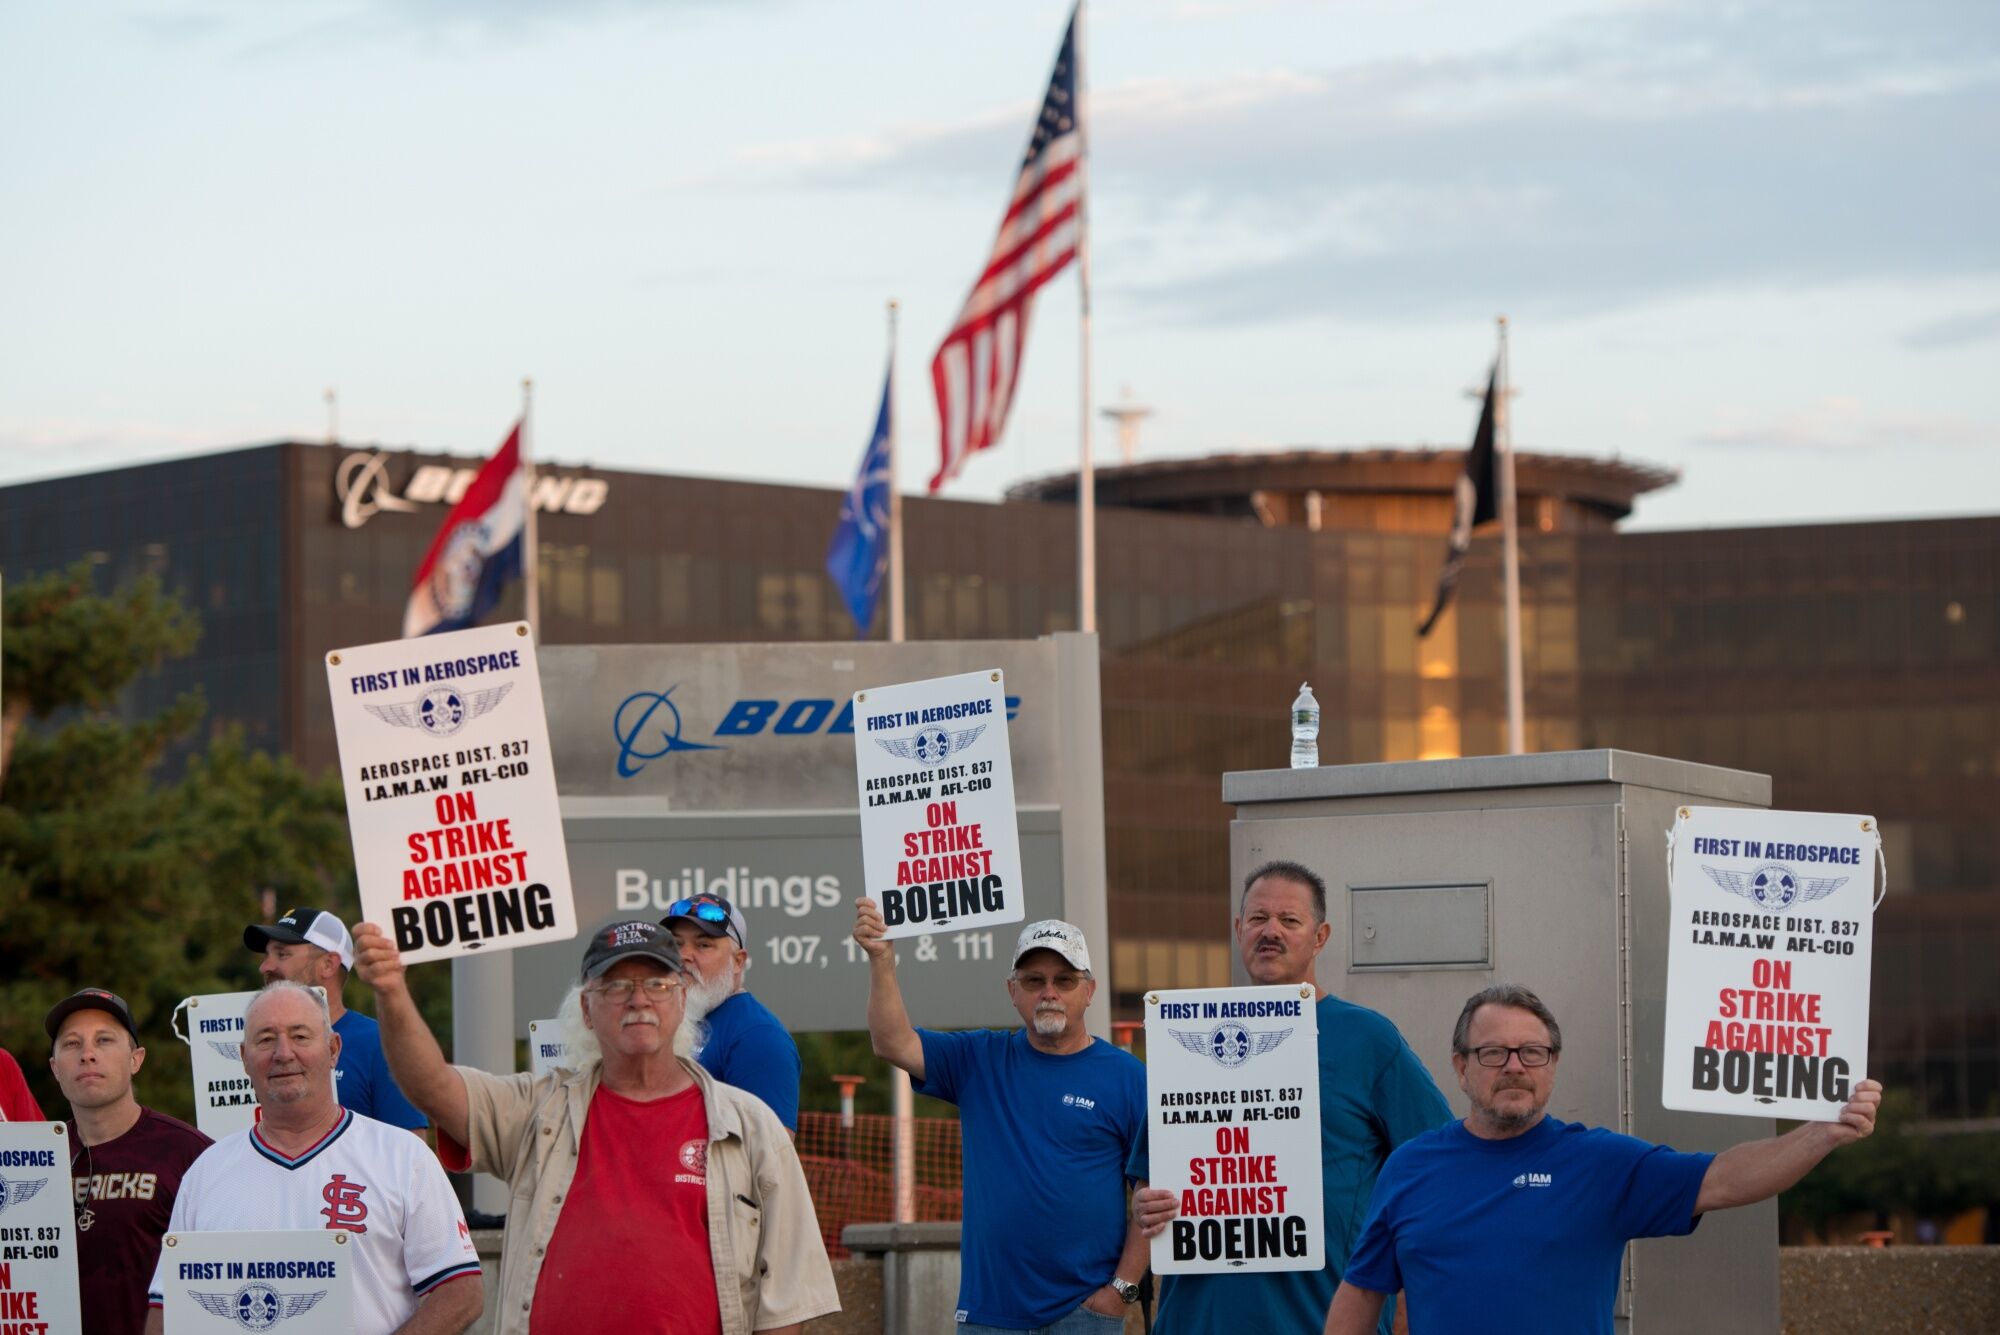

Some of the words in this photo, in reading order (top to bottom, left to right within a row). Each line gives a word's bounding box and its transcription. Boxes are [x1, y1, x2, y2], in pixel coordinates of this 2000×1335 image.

[351, 670, 399, 695] FIRST
[403, 667, 421, 686] IN
[425, 650, 521, 683] AEROSPACE
[867, 713, 903, 731] FIRST
[905, 711, 919, 726] IN
[921, 699, 993, 723] AEROSPACE
[361, 753, 451, 782] AEROSPACE
[456, 746, 497, 766] DIST.
[501, 740, 530, 758] 837
[866, 770, 935, 791] AEROSPACE
[938, 765, 968, 780] DIST.
[971, 760, 993, 774] 837
[365, 775, 448, 802] I.A.M.A.W
[461, 761, 529, 787] AFL-CIO
[869, 787, 932, 807] I.A.M.A.W
[940, 777, 992, 797] AFL-CIO
[435, 790, 477, 826] ON
[926, 800, 957, 828] ON
[408, 818, 514, 864] STRIKE
[903, 823, 983, 857] STRIKE
[1694, 837, 1741, 856] FIRST
[1744, 841, 1761, 858] IN
[1764, 842, 1861, 865] AEROSPACE
[402, 851, 528, 901] AGAINST
[897, 850, 993, 886] AGAINST
[615, 867, 842, 917] Buildings
[881, 874, 1005, 926] BOEING
[391, 883, 556, 952] BOEING
[1692, 910, 1780, 931] AEROSPACE
[1786, 917, 1825, 934] DIST.
[1831, 920, 1860, 936] 837
[765, 935, 828, 968] 107,
[915, 934, 939, 961] &
[953, 932, 994, 961] 111
[1692, 930, 1775, 950] I.A.M.A.W
[1786, 937, 1855, 956] AFL-CIO
[1752, 958, 1792, 990] ON
[1160, 1003, 1199, 1019] FIRST
[1203, 1002, 1217, 1018] IN
[1221, 1000, 1302, 1018] AEROSPACE
[1719, 988, 1822, 1024] STRIKE
[200, 1018, 232, 1033] FIRST
[1705, 1020, 1832, 1058] AGAINST
[208, 1078, 254, 1092] AEROSP
[1692, 1046, 1850, 1103] BOEING
[210, 1093, 260, 1108] I.A.M.A.
[1075, 1096, 1095, 1108] IAM
[1160, 1090, 1236, 1107] AEROSPACE
[1241, 1089, 1275, 1104] DIST.
[1279, 1087, 1303, 1101] 837
[1162, 1109, 1233, 1125] I.A.M.A.W
[1242, 1106, 1301, 1122] AFL-CIO
[1216, 1126, 1249, 1155] ON
[0, 1150, 55, 1167] OSPACE
[1189, 1155, 1277, 1186] STRIKE
[72, 1172, 158, 1204] ERICKS
[1528, 1173, 1552, 1183] IAM
[1180, 1186, 1288, 1217] AGAINST
[1, 1228, 33, 1241] DIST.
[37, 1227, 60, 1241] 837
[1172, 1215, 1308, 1261] BOEING
[3, 1245, 59, 1260] AFL-CIO
[179, 1263, 223, 1280] FIRST
[227, 1262, 243, 1279] IN
[247, 1261, 336, 1279] AEROSPACE
[0, 1292, 39, 1319] IKE
